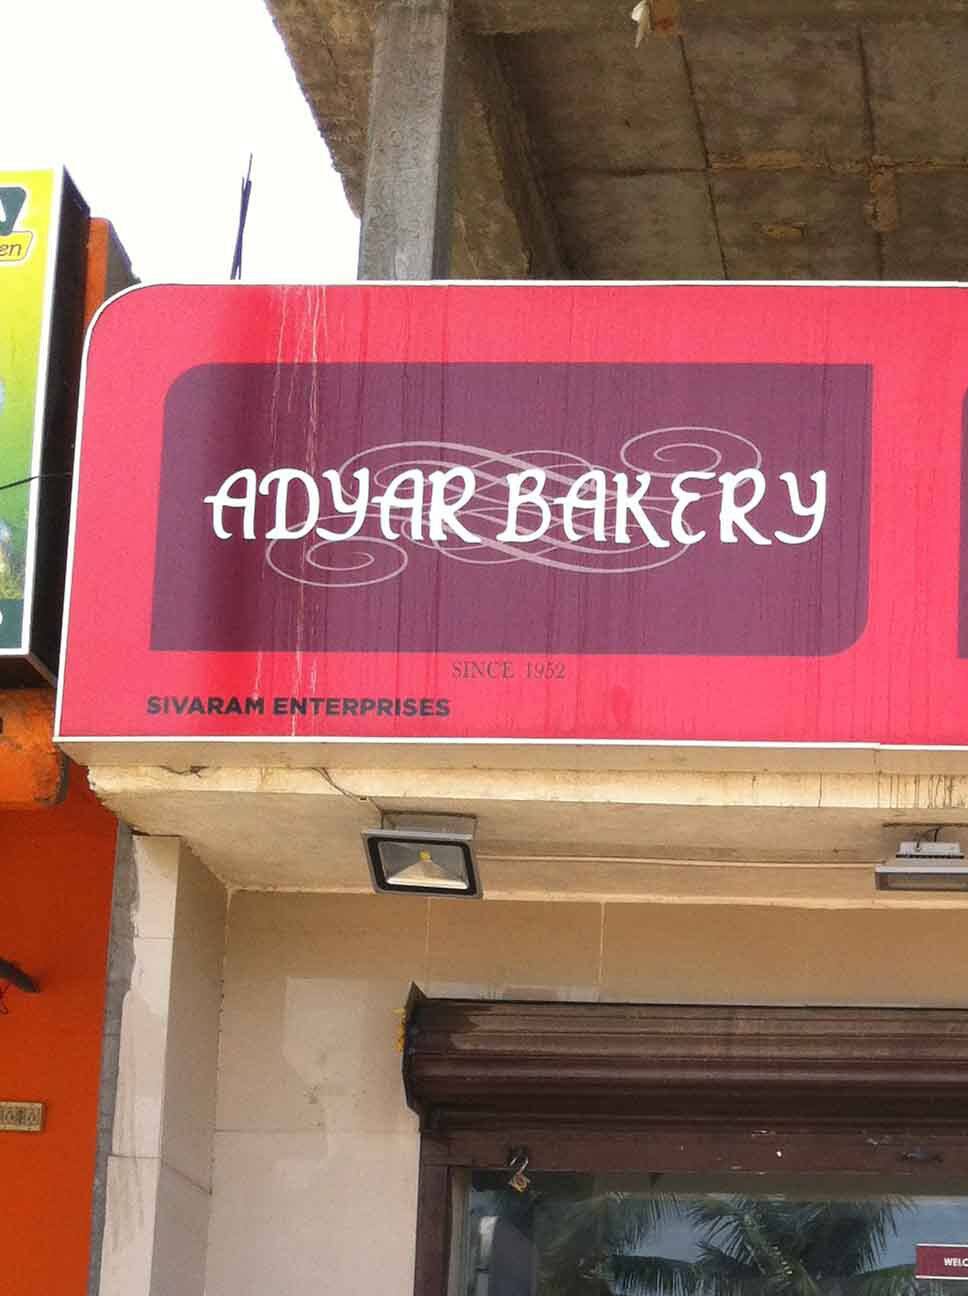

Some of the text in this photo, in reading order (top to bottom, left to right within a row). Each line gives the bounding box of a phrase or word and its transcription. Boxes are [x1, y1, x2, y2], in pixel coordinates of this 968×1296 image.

[203, 466, 827, 548] ADYAR BAKERY
[450, 661, 567, 681] SINCE 1952
[146, 695, 451, 717] SIVARAM ENTERPRISES
